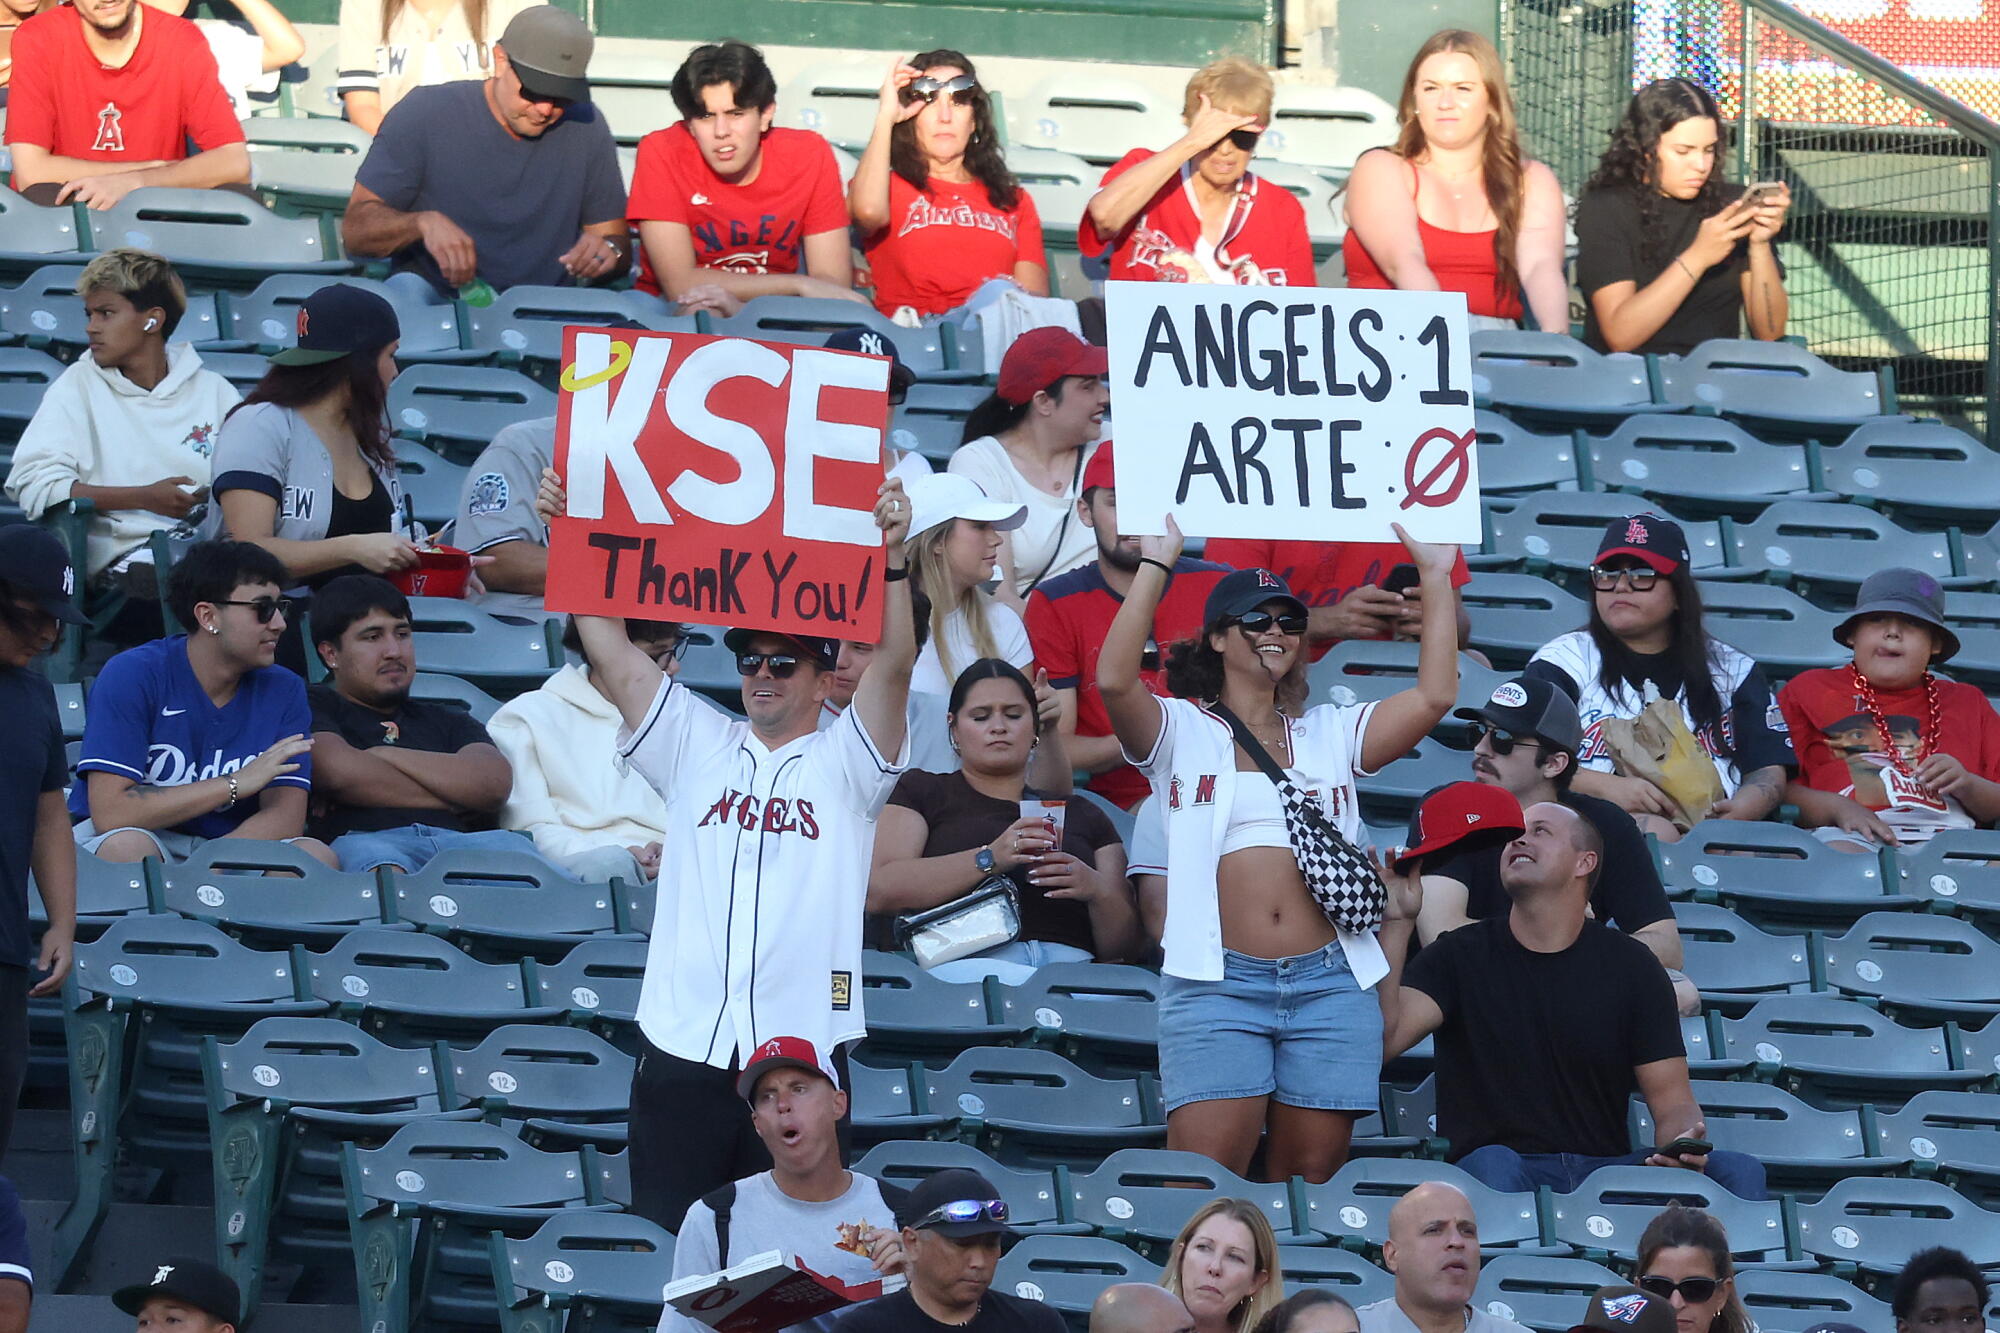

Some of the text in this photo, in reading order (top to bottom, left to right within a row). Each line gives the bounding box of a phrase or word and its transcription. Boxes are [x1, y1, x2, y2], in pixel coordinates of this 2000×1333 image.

[566, 332, 890, 547] KSE
[281, 485, 315, 521] EW
[762, 550, 872, 626] You!
[205, 890, 217, 902] 12
[439, 900, 449, 913] 11
[581, 992, 591, 1005] 11
[261, 1069, 272, 1083] 13
[497, 1076, 509, 1089] 12
[554, 1266, 566, 1279] 13
